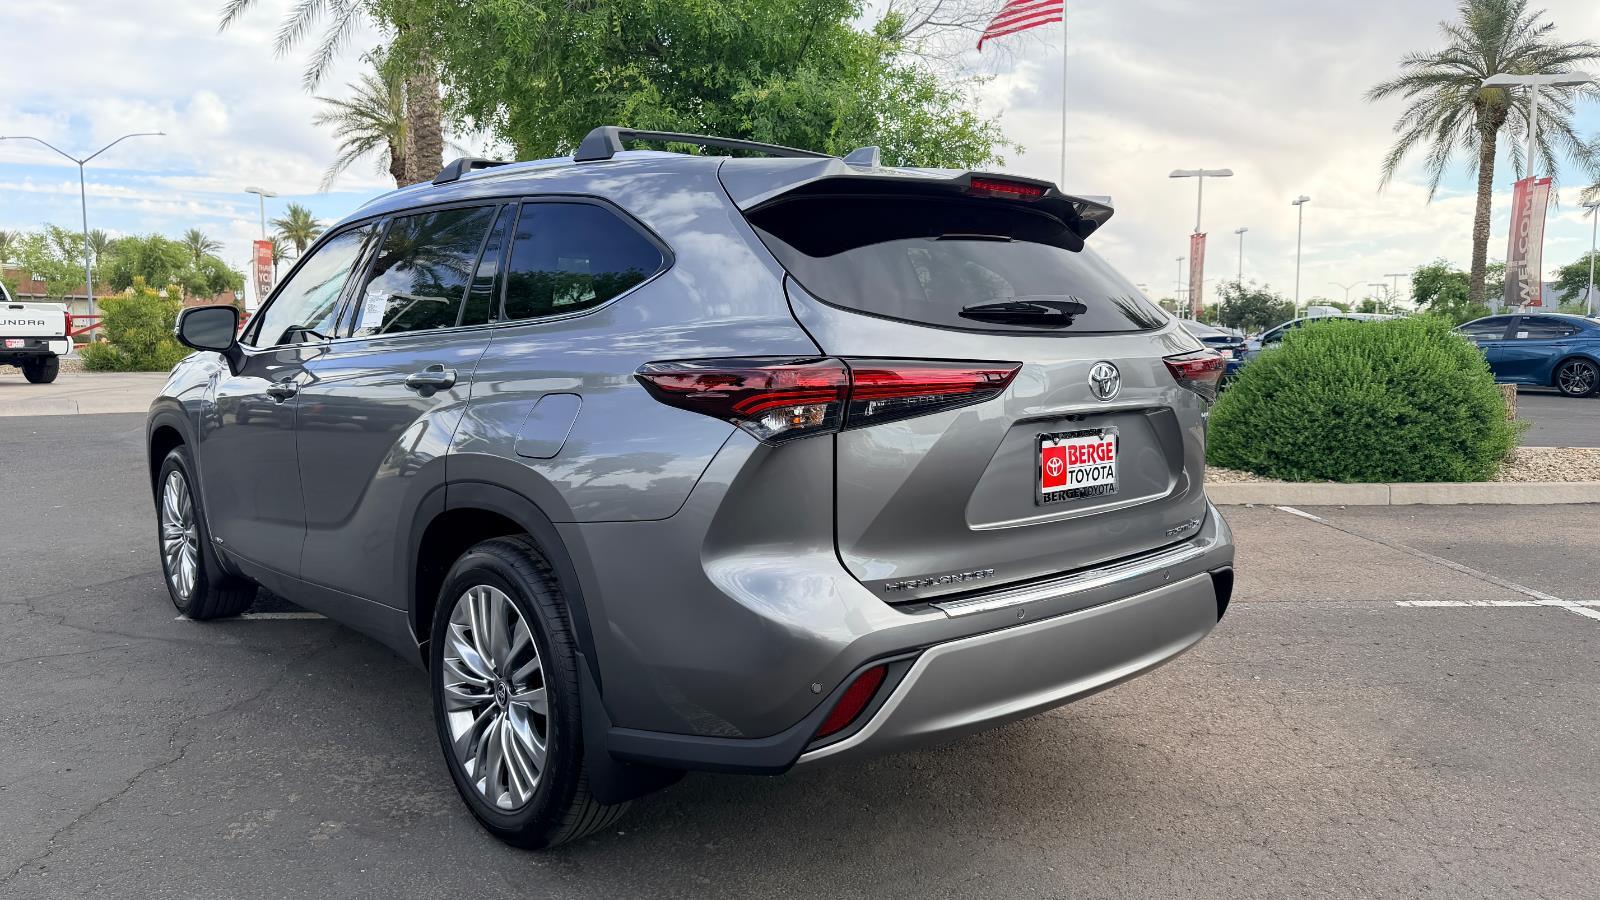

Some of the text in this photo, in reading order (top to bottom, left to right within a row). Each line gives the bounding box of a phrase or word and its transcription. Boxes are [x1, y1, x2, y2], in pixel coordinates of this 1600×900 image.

[1518, 180, 1534, 308] WELCOME
[1067, 442, 1114, 465] BERGE
[1068, 466, 1114, 484] TOYOTA
[1043, 483, 1115, 503] BERGE TOYOTA
[885, 568, 995, 592] HIGHLANDER
